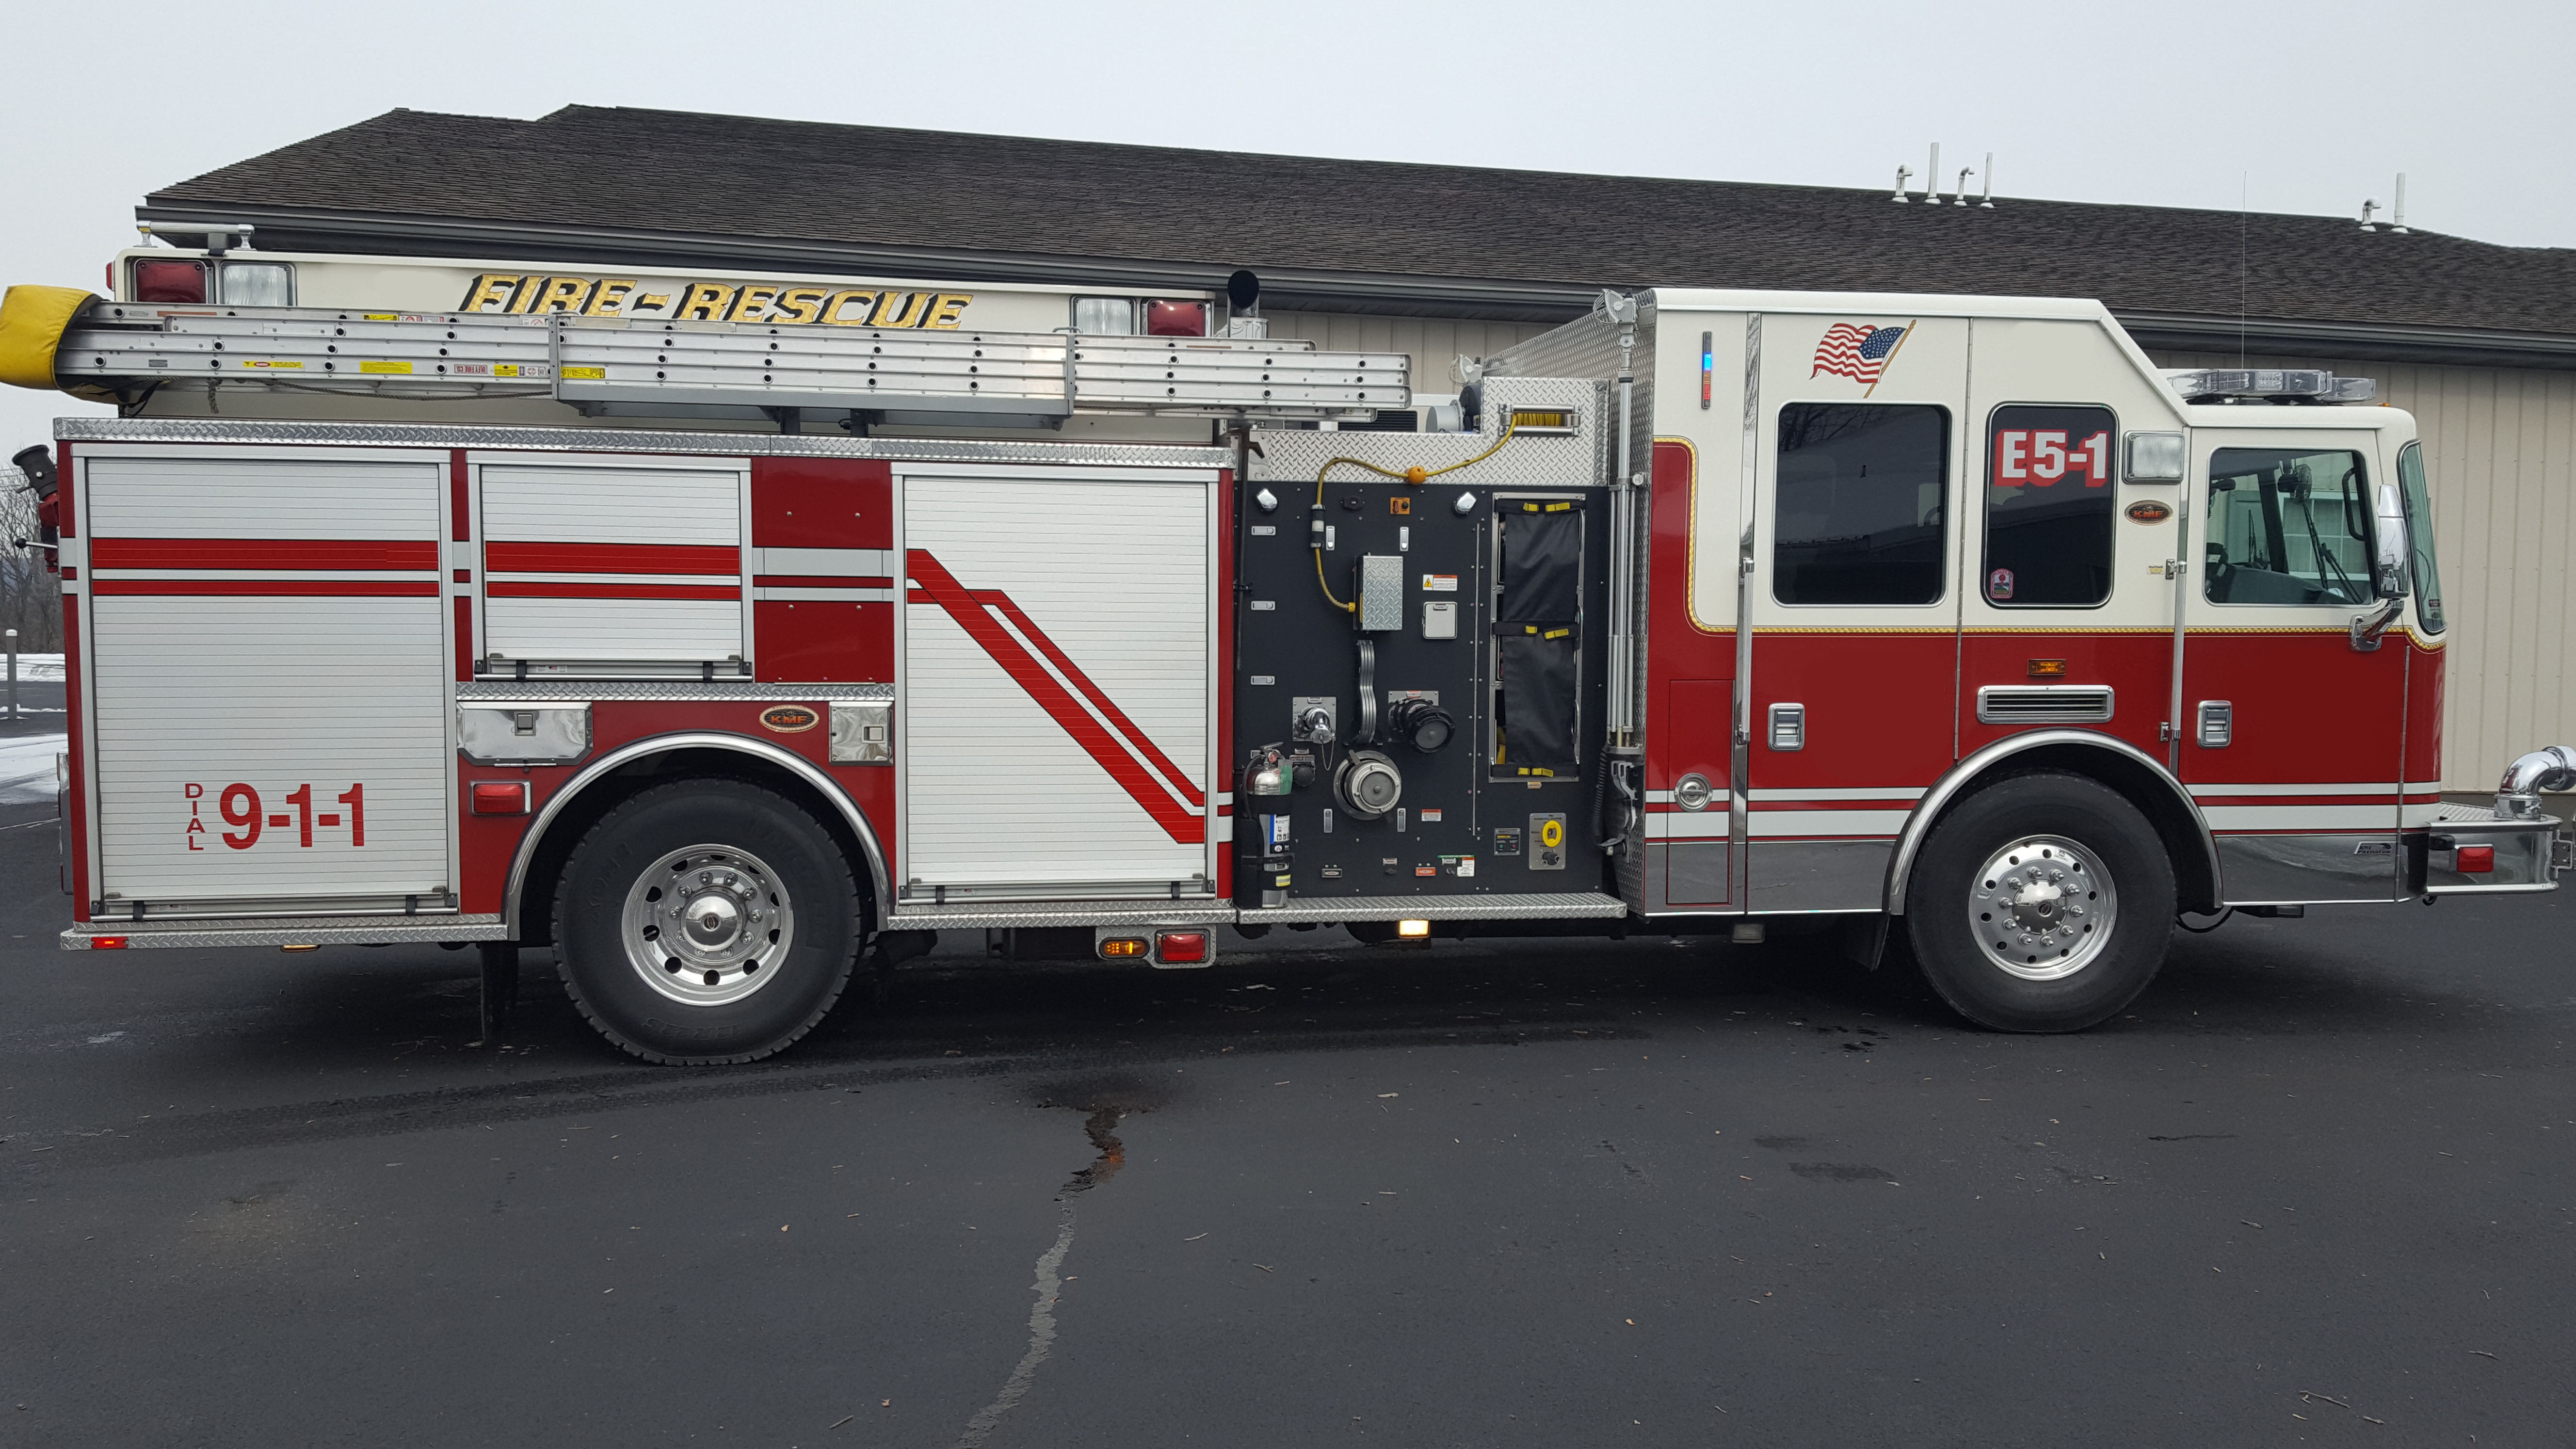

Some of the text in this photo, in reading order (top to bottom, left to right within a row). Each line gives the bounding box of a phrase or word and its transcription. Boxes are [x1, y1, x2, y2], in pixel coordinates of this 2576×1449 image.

[1994, 429, 2109, 487] E5-1
[771, 715, 808, 724] KME
[184, 783, 205, 851] DIAL
[220, 783, 365, 850] 9-1-1
